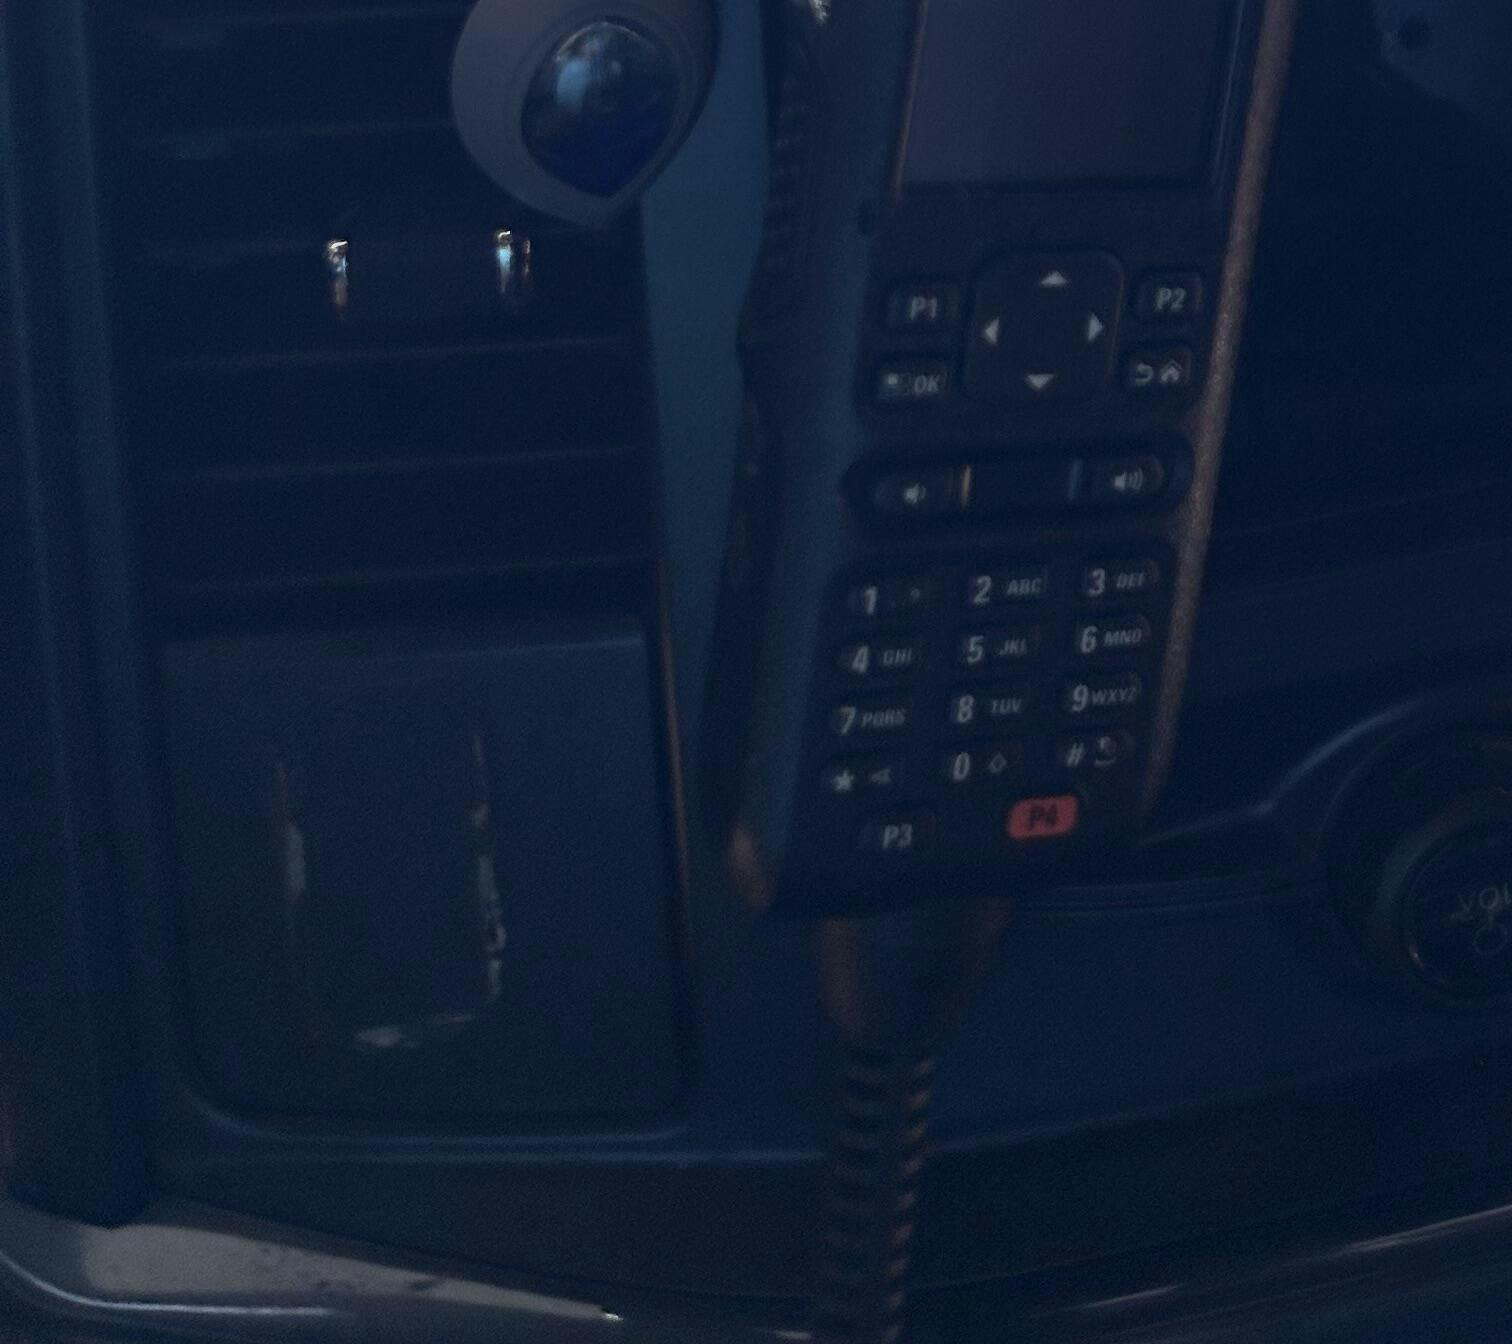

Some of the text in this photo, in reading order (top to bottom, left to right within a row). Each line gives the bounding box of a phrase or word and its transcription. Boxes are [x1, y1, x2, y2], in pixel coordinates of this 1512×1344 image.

[906, 295, 939, 321] P1
[1154, 287, 1187, 313] P2
[913, 375, 940, 393] OK
[973, 575, 1043, 606] 2 ABC
[1087, 567, 1106, 598] 3
[863, 585, 879, 614] 1
[966, 635, 985, 664] 5
[1079, 625, 1143, 654] 6 MNO
[850, 645, 914, 674] 4 GHI
[956, 695, 976, 724] 8
[1070, 683, 1138, 712] 9 WXYZ
[839, 706, 858, 736] 7
[952, 752, 971, 782] 0
[1029, 803, 1059, 828] P4
[882, 823, 913, 850] P3
